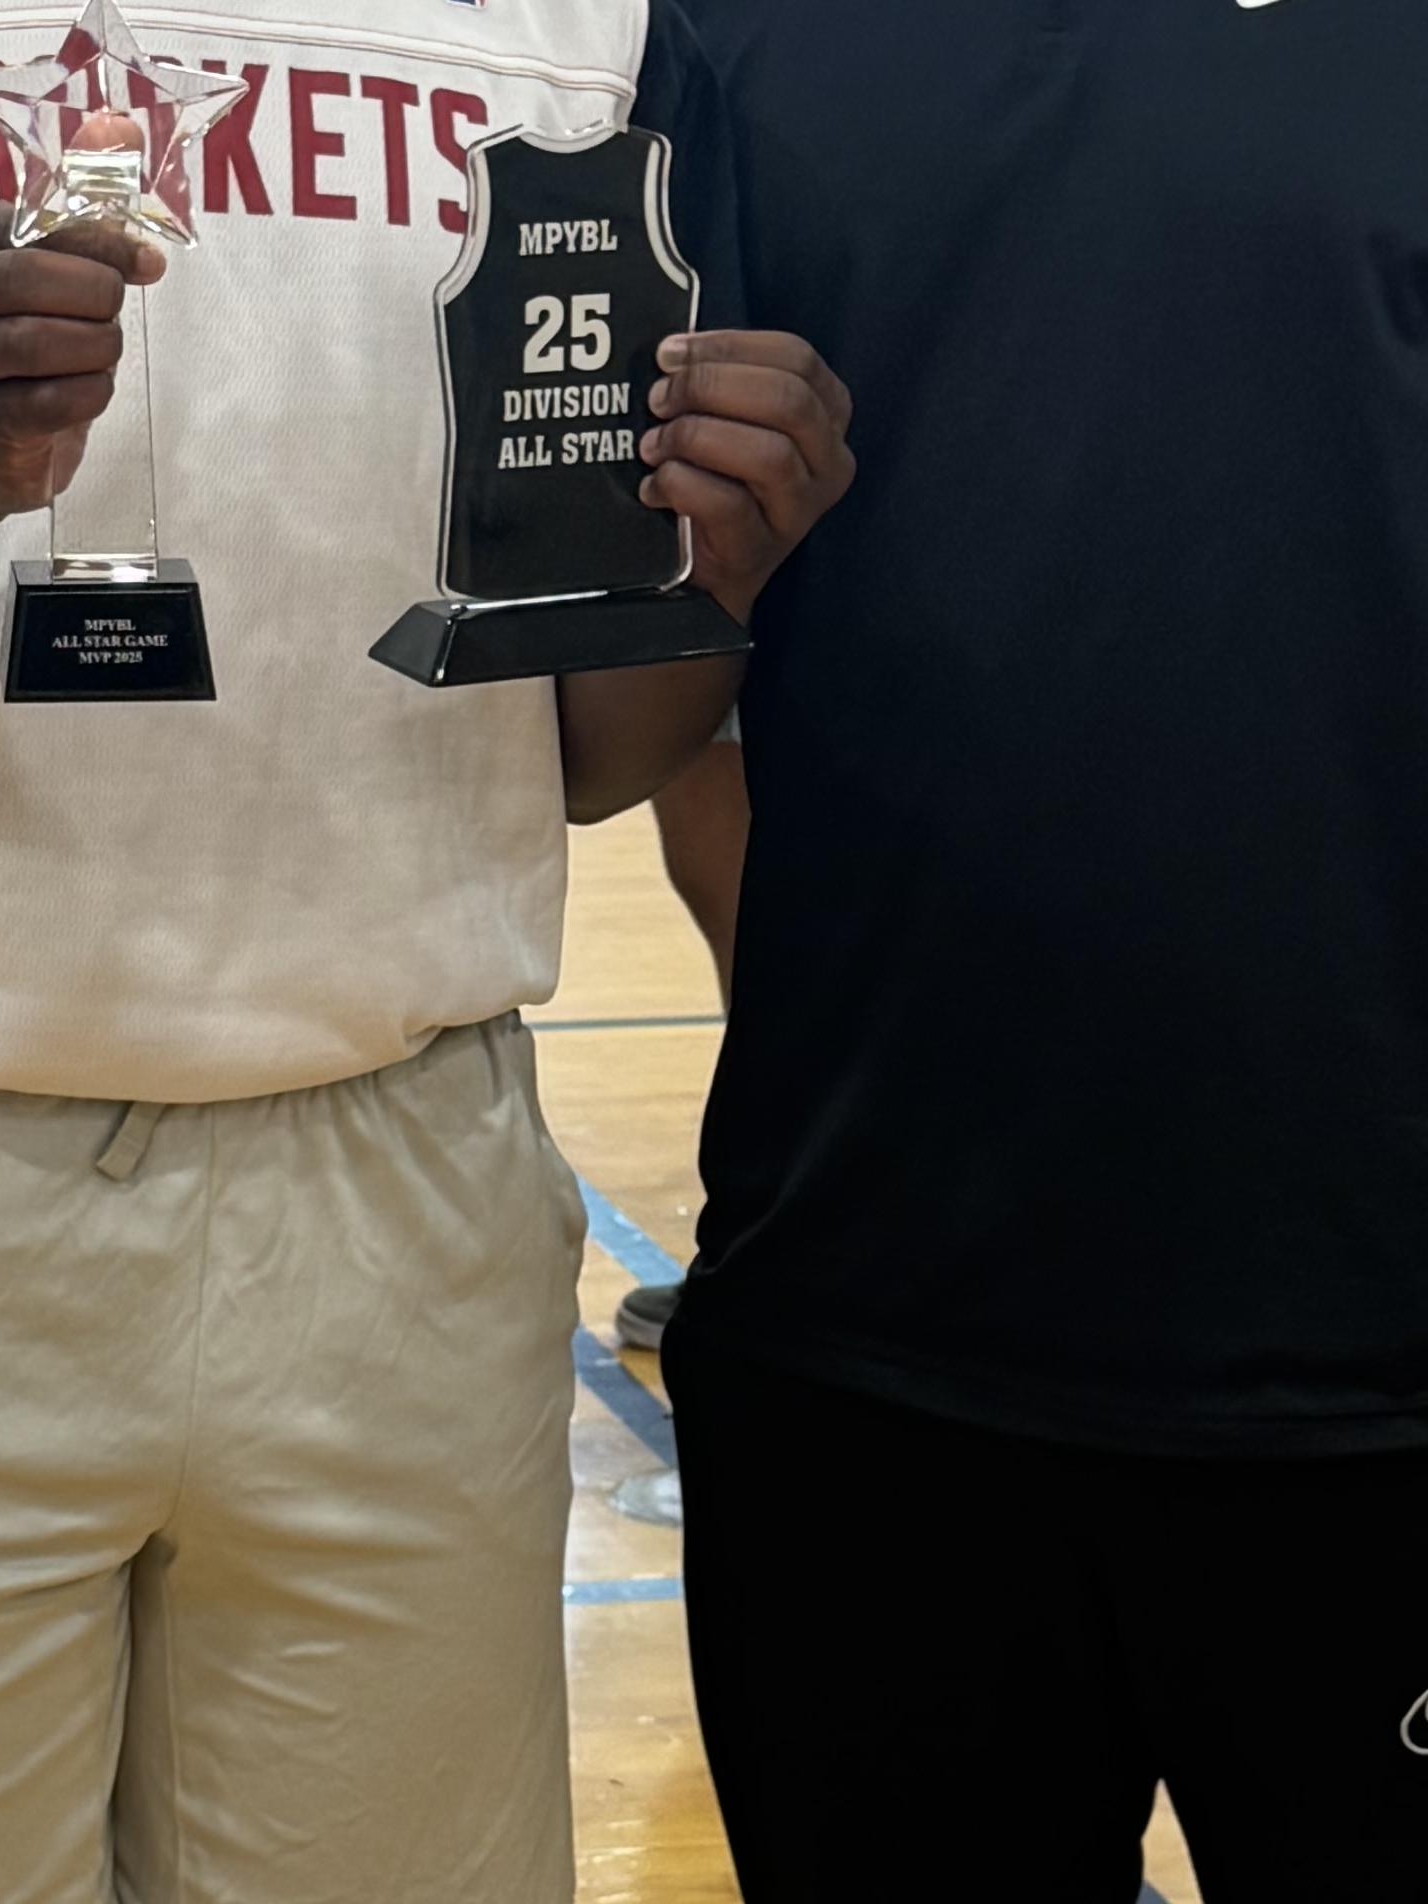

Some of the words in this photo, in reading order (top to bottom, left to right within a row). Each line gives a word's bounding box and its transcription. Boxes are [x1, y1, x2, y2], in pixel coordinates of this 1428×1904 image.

[519, 219, 617, 256] MPYBL
[523, 293, 611, 373] 25
[503, 382, 630, 422] DIVISION
[497, 435, 552, 469] ALL
[561, 429, 635, 465] STAR
[52, 635, 81, 648] ALL
[83, 635, 122, 648] STAR
[124, 634, 168, 647] GAME
[79, 651, 112, 664] MVP
